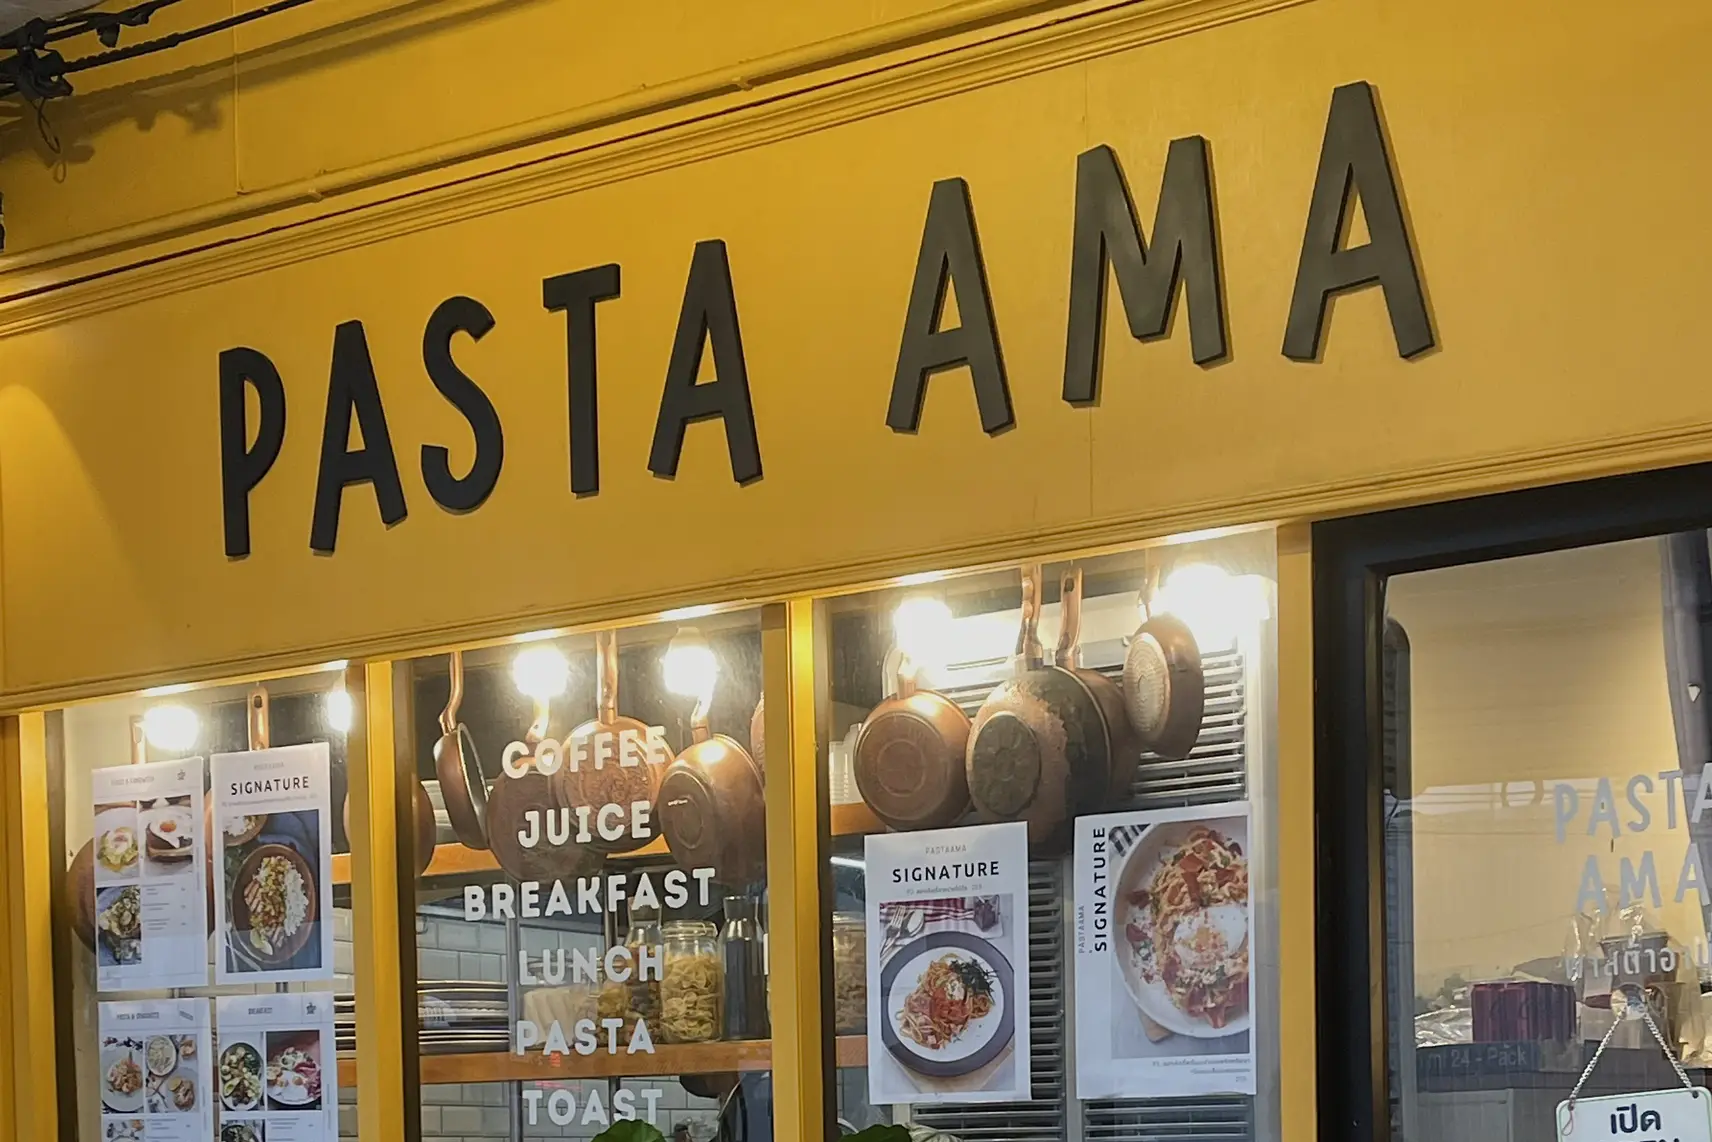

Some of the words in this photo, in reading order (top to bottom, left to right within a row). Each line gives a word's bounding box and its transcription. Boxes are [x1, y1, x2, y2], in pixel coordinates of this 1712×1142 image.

[219, 239, 763, 558] PASTA
[886, 80, 1437, 435] AMA
[502, 725, 667, 779] COFFEE
[230, 776, 310, 796] SIGNATURE
[1554, 762, 1712, 845] PASTA
[517, 800, 652, 848] JUICE
[464, 867, 716, 922] BREAKFAST
[892, 861, 1000, 883] SIGNATURE
[1092, 827, 1107, 952] SIGNATURE
[1575, 842, 1711, 916] AMA
[518, 944, 665, 986] LUNCH
[516, 1017, 656, 1056] PASTA
[522, 1088, 663, 1126] TOAST
[1610, 1103, 1662, 1135] เปิด
